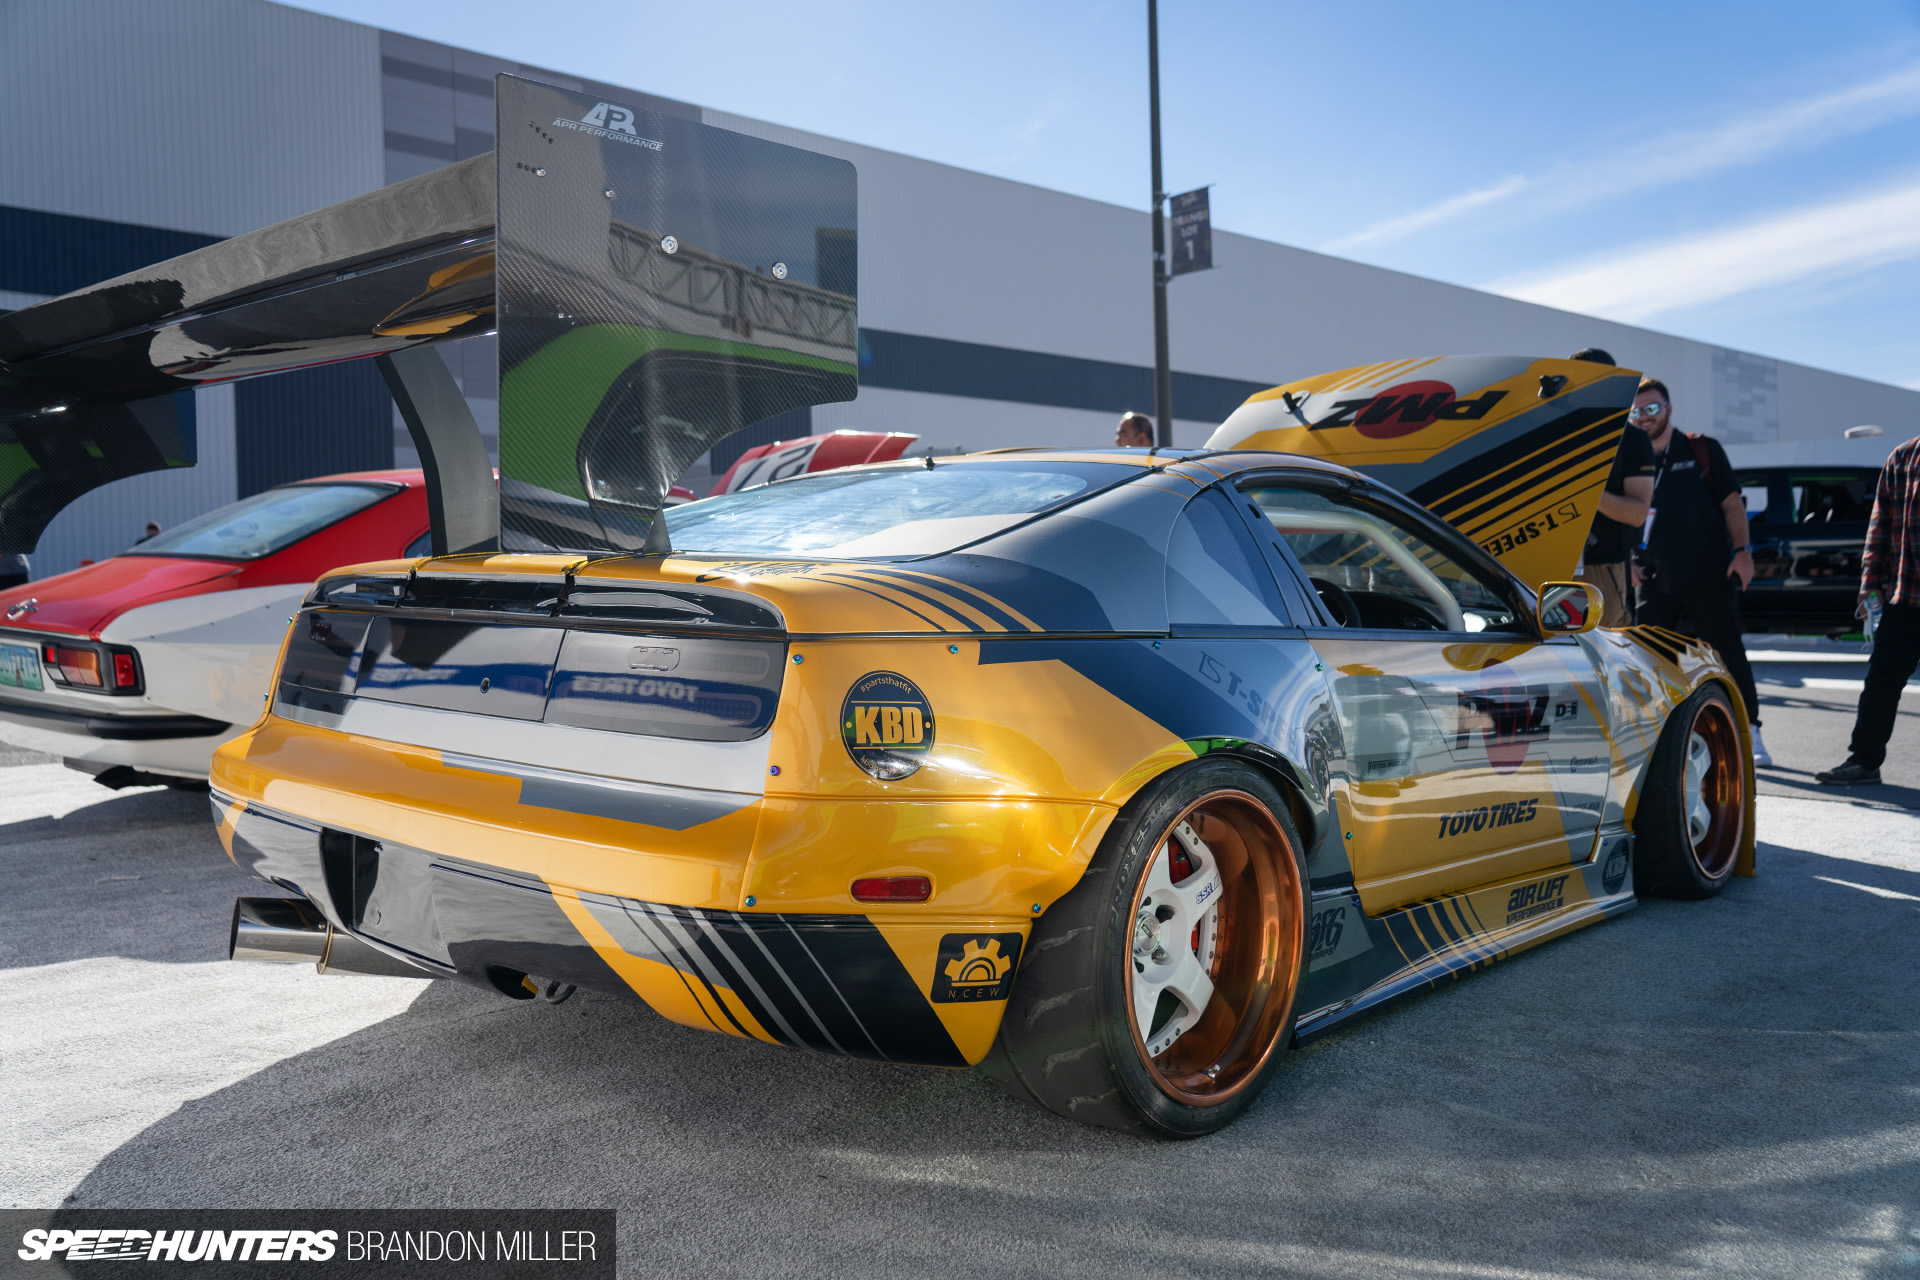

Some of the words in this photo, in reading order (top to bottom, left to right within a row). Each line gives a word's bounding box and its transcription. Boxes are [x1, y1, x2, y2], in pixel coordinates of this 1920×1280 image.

[552, 120, 577, 130] APR
[579, 125, 663, 151] PERFORMANCE
[1308, 390, 1510, 432] PMZ
[860, 676, 912, 695] #partsthatfit
[855, 706, 923, 744] KBD
[1438, 806, 1489, 839] TOYO
[1488, 798, 1539, 829] TIRES
[1196, 882, 1214, 905] SSR
[1536, 874, 1570, 903] LIFT
